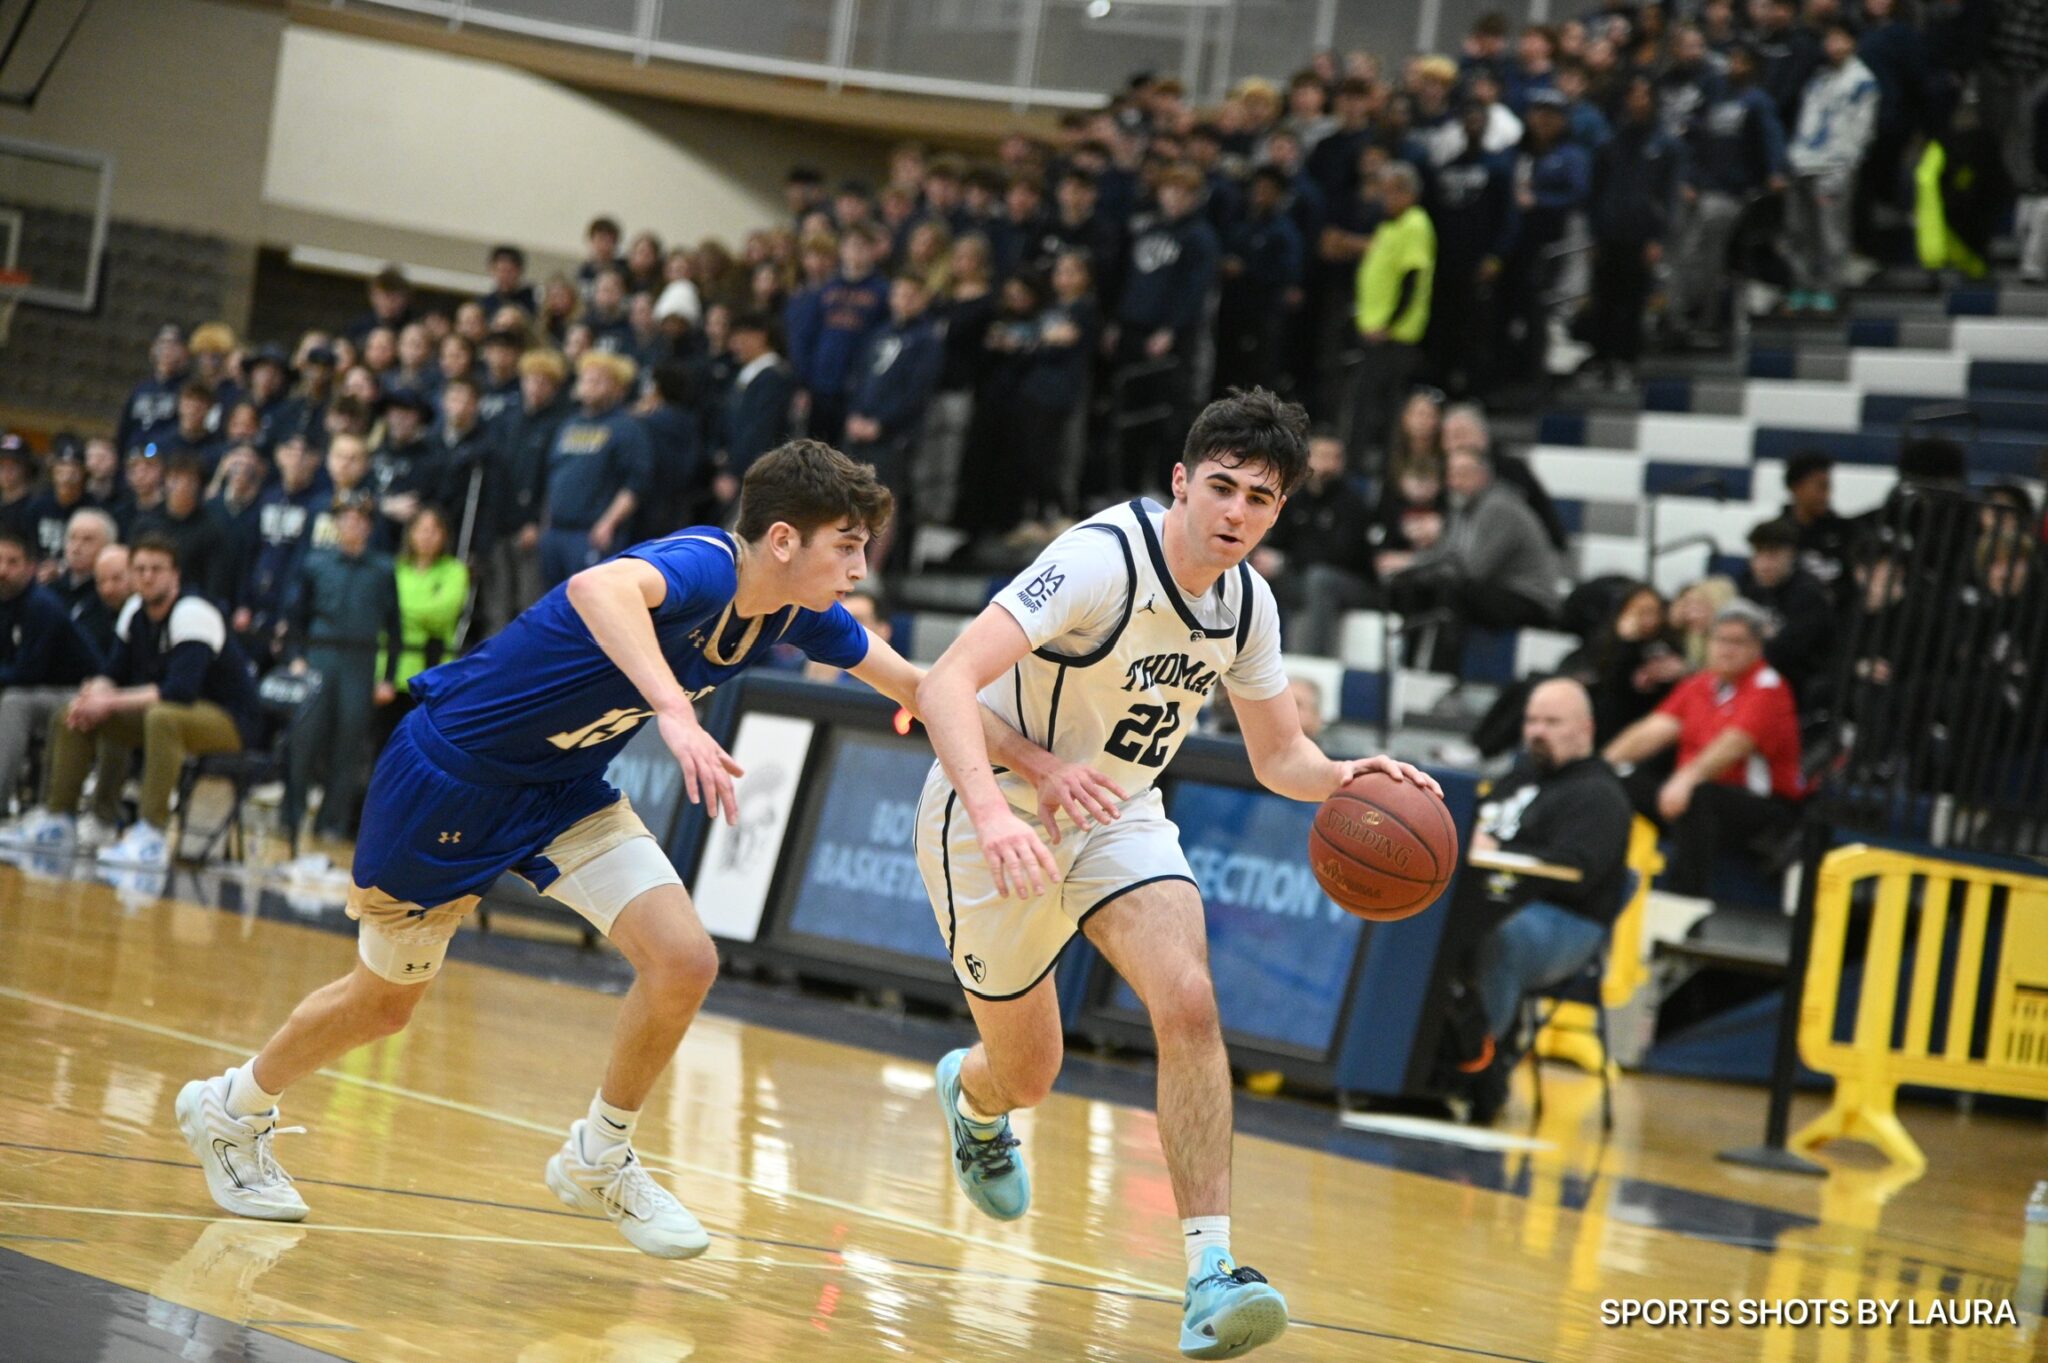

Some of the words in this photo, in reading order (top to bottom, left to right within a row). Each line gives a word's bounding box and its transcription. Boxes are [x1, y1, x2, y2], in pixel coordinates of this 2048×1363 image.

[1016, 590, 1039, 614] HOOPS
[1103, 701, 1180, 768] 22
[867, 800, 916, 847] BO
